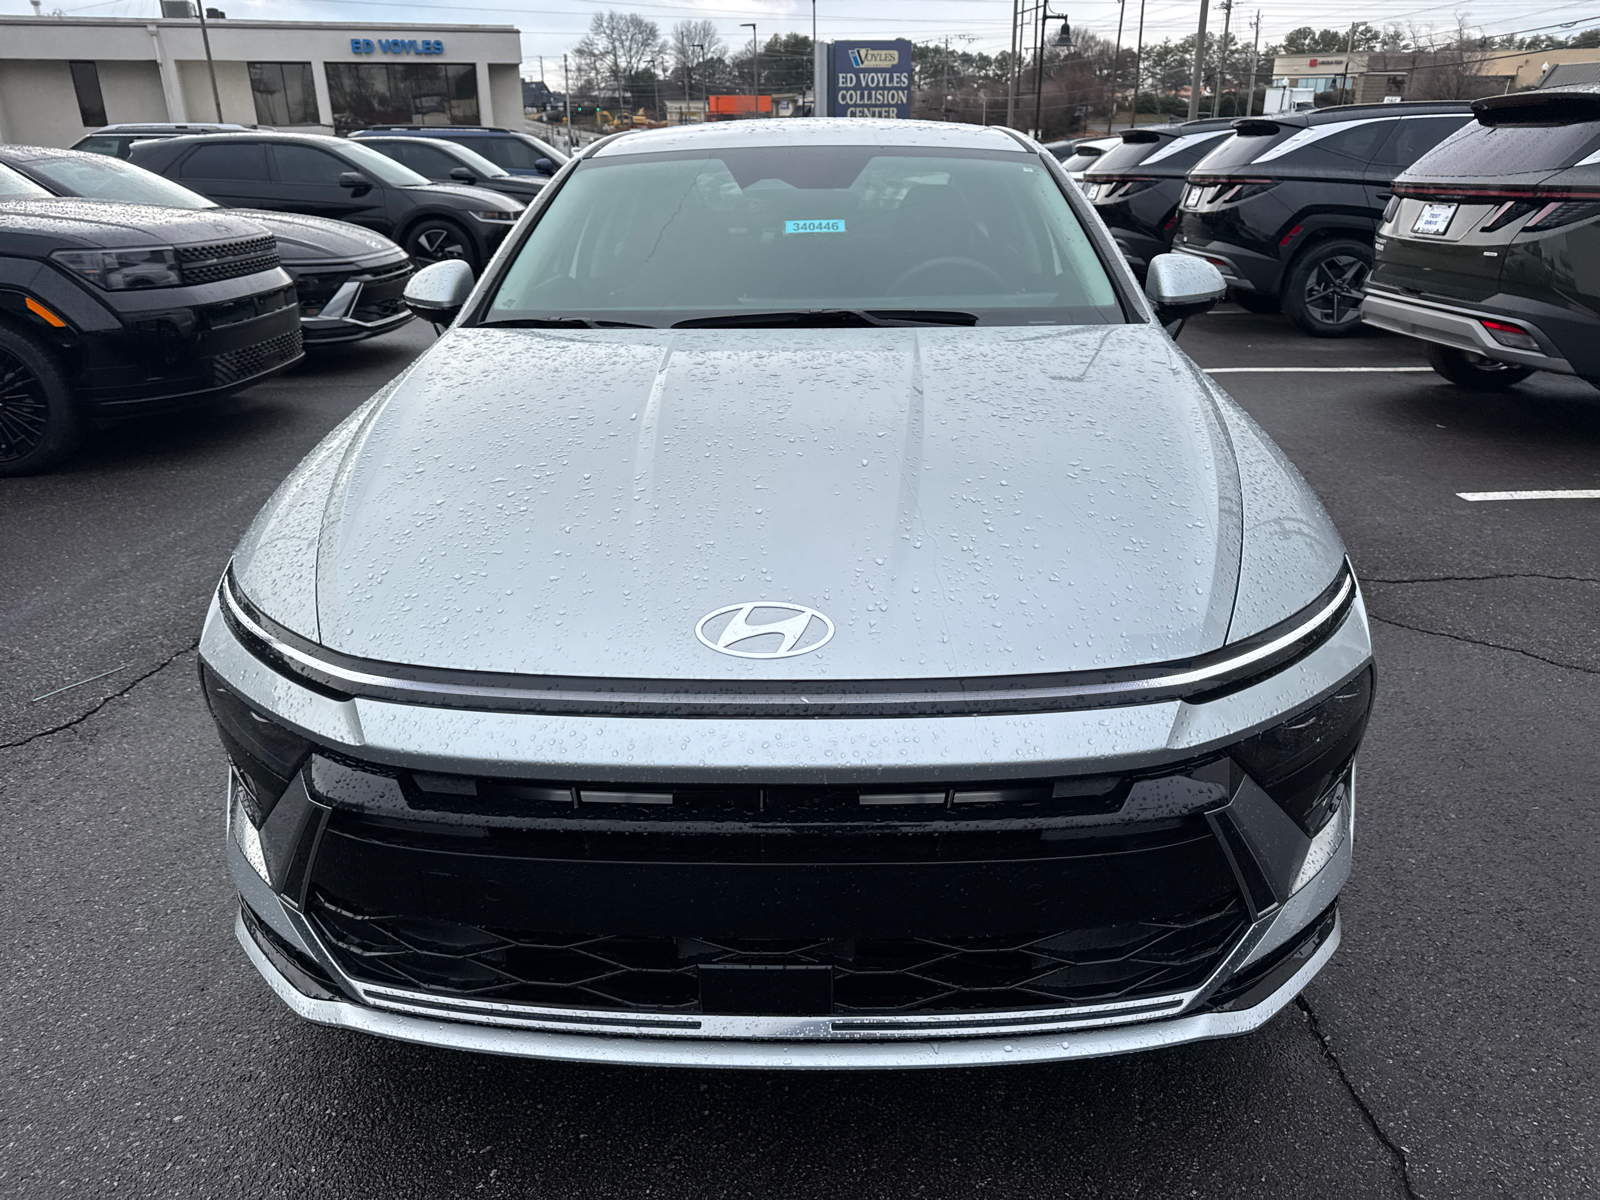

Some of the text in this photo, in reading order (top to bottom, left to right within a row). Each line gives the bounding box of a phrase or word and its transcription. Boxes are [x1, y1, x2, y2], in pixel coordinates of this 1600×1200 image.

[350, 38, 444, 55] ED VOYLES
[856, 49, 896, 66] VOYLES
[838, 72, 908, 87] ED VOYLES
[838, 90, 908, 105] COLLISION
[847, 107, 897, 119] CENTER
[793, 222, 839, 231] 340446
